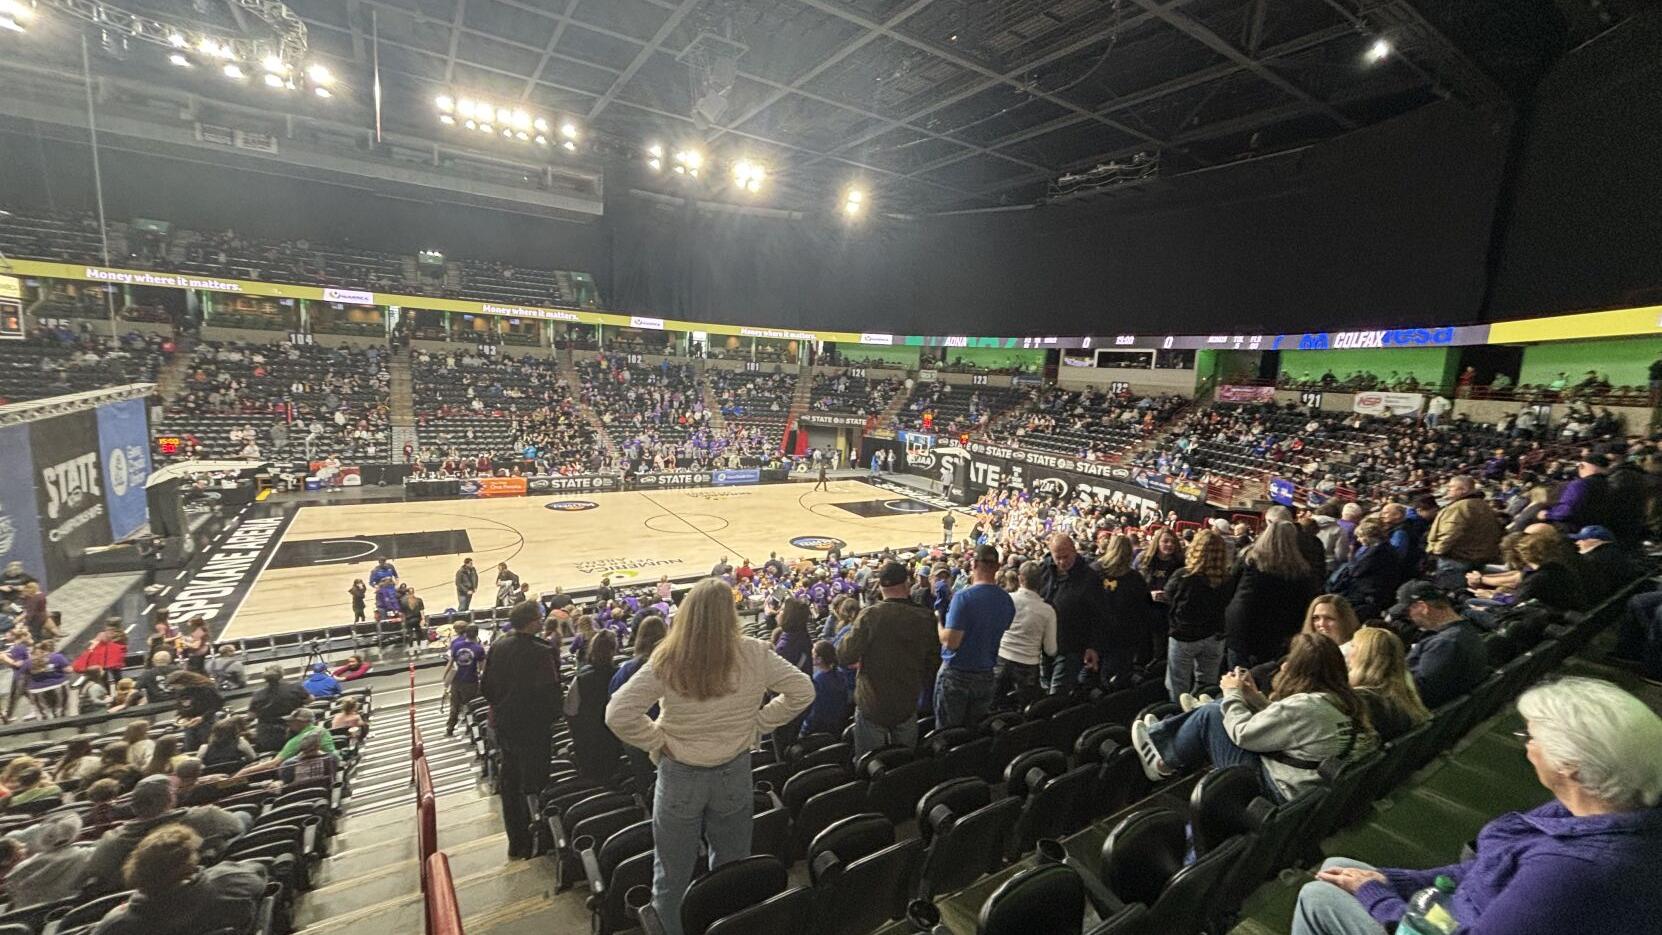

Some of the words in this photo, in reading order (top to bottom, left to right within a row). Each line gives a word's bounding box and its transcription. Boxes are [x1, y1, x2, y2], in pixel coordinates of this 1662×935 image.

[86, 268, 131, 283] Money
[134, 273, 175, 285] where
[177, 276, 188, 287] it
[189, 278, 242, 291] matters.
[482, 303, 511, 317] Money
[511, 307, 537, 317] where
[944, 337, 967, 347] ADNA
[1082, 337, 1091, 348] 0
[1163, 336, 1174, 348] 0
[1334, 330, 1386, 348] COLFAX
[627, 354, 642, 364] 102
[852, 369, 865, 377] 124
[973, 376, 987, 385] 123
[811, 415, 833, 424] STATE
[845, 418, 867, 426] STATE
[986, 446, 1013, 459] STATE
[1026, 453, 1057, 468] STATE
[1076, 462, 1111, 477] STATE
[551, 478, 591, 488] STATE
[658, 474, 693, 484] STATE
[43, 451, 101, 519] STATE
[167, 550, 261, 624] SPOKANE
[220, 516, 285, 549] ARENA
